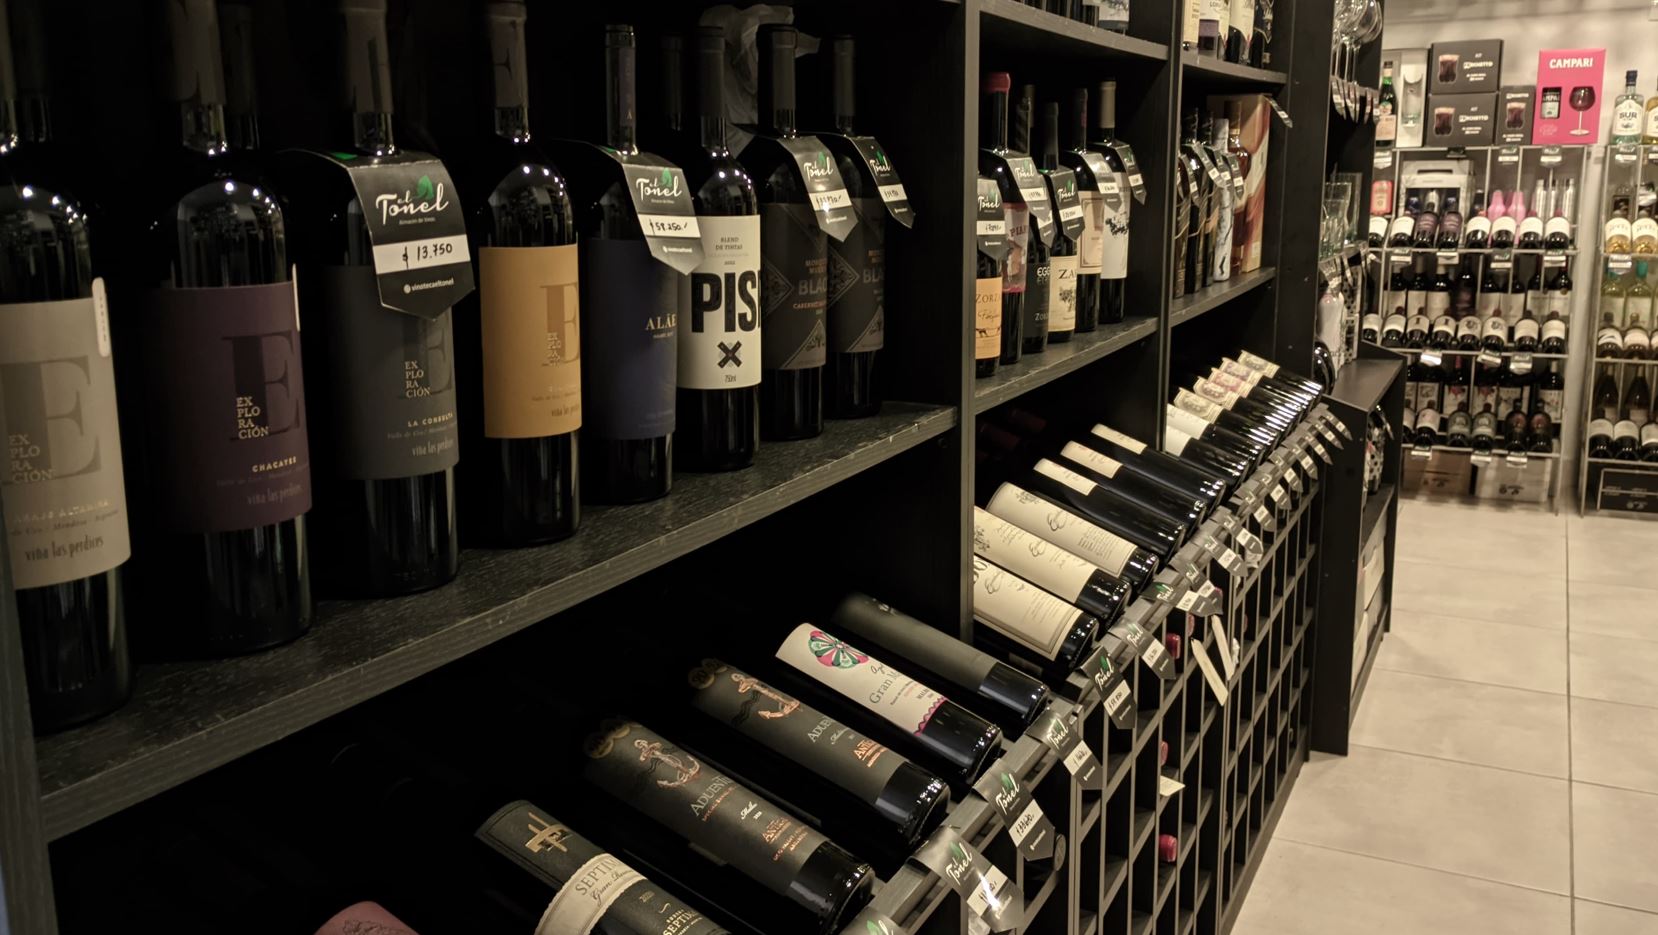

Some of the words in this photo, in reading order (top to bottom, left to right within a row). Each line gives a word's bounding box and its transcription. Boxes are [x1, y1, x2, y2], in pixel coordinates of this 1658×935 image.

[1549, 57, 1594, 69] CAMPARI
[636, 175, 683, 201] Tonel
[376, 182, 449, 226] Tonel
[691, 270, 761, 333] PIS
[404, 360, 418, 370] EX
[405, 369, 425, 379] PLO
[406, 380, 418, 389] RA
[236, 396, 253, 408] EX
[236, 406, 261, 418] PLO
[237, 418, 255, 429] RA
[238, 425, 269, 440] CIÓN
[8, 434, 30, 446] EX
[9, 445, 41, 459] PLO
[11, 460, 32, 472] RA
[869, 678, 893, 704] Gran
